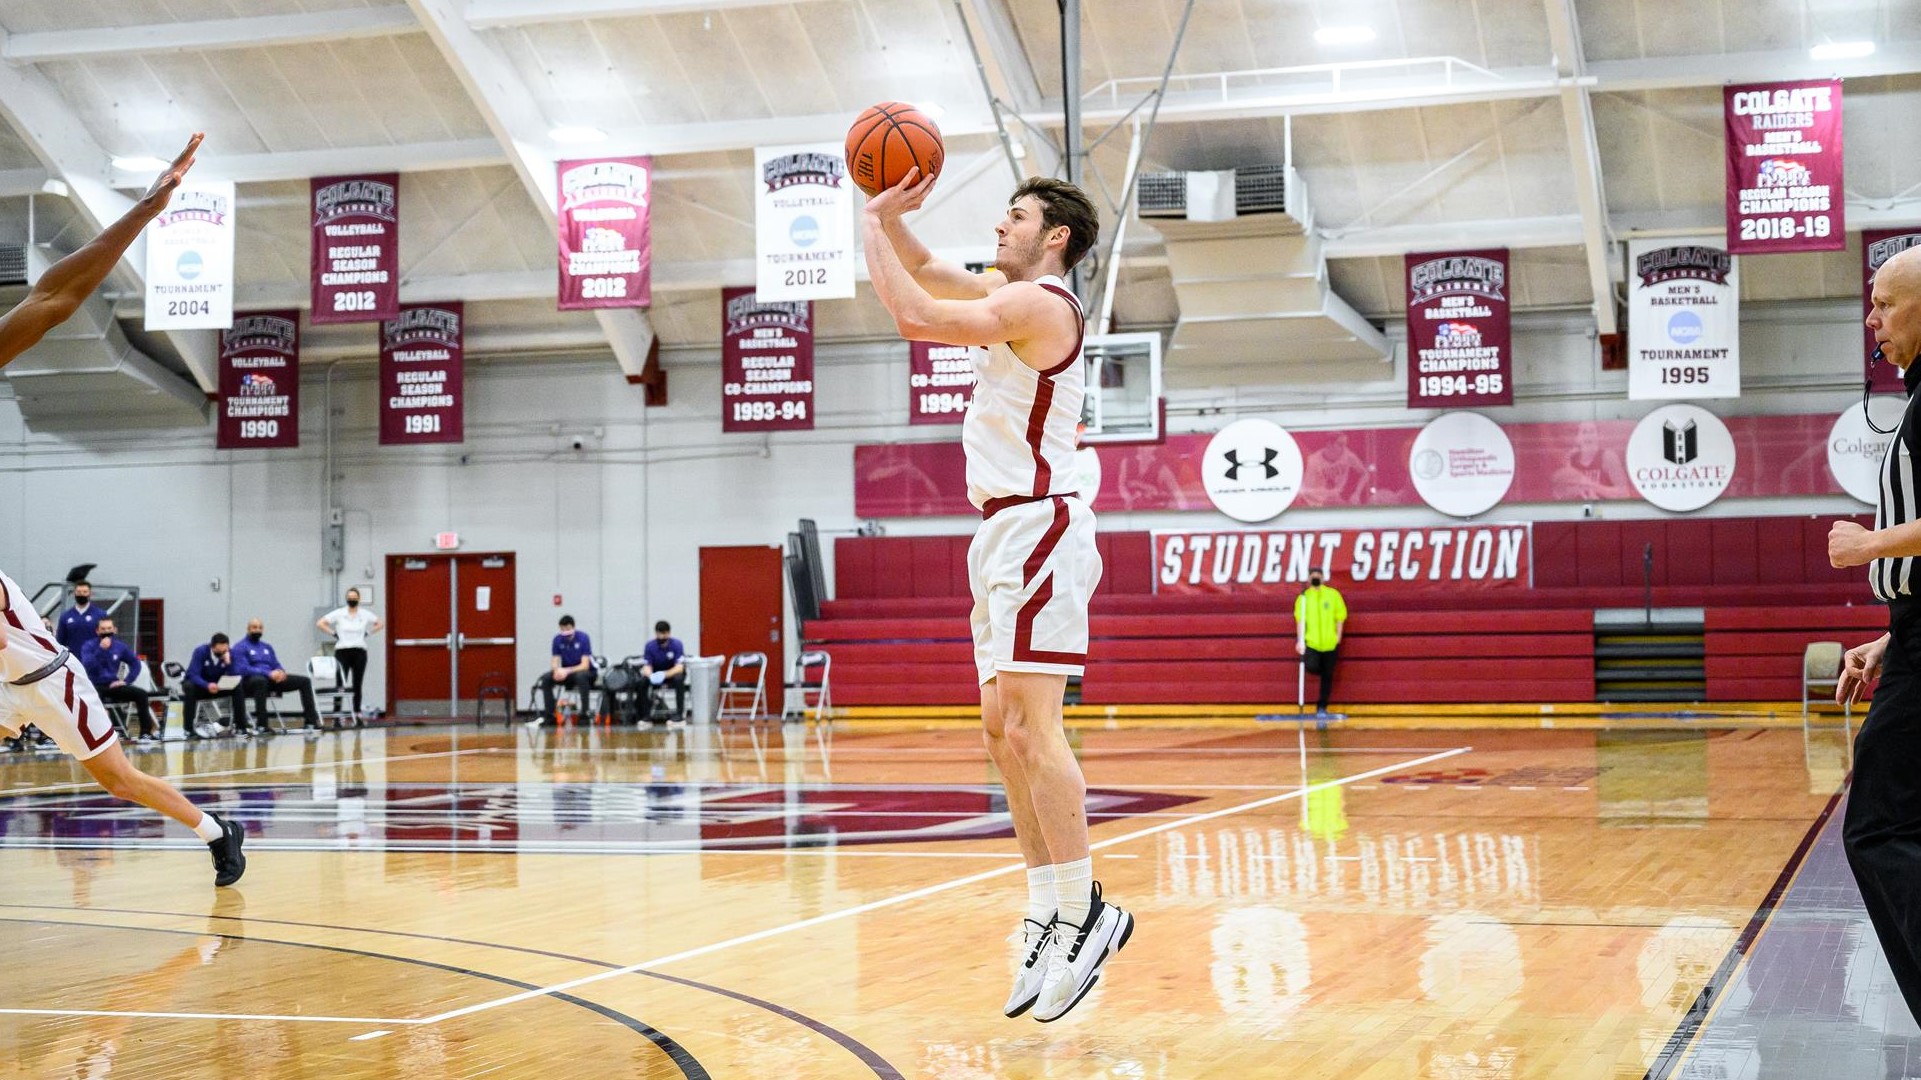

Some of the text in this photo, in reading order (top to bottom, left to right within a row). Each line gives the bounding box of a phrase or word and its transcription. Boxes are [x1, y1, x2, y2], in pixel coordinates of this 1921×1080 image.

[1733, 86, 1832, 116] COLGATE
[1752, 112, 1814, 130] RAIDERS
[1745, 140, 1823, 157] BASKETBALL
[1739, 184, 1831, 201] REGULAR SEASON
[1739, 197, 1831, 215] CHAMPIONS
[325, 223, 385, 236] VOLLEYBALL
[1740, 215, 1831, 241] 2018-19
[328, 245, 381, 259] REGULAR
[766, 250, 843, 264] TOURNAMENT
[332, 258, 377, 272] SEASON
[1637, 245, 1732, 277] COLGATE
[321, 270, 389, 286] CHAMPIONS
[784, 268, 827, 286] 2012
[1411, 256, 1504, 290] COLGATE
[1650, 269, 1718, 283] RAIDERS
[154, 284, 223, 294] TOURNAMENT
[582, 276, 627, 298] 2012
[1425, 281, 1490, 296] RAIDERS
[168, 300, 209, 316] 2004
[334, 291, 376, 312] 2012
[1441, 296, 1475, 308] MEN'S
[1650, 296, 1718, 306] BASKETBALL
[1424, 305, 1492, 319] BASKETBALL
[393, 349, 450, 362] VOLLEYBALL
[1418, 346, 1499, 360] TOURNAMENT
[1640, 349, 1729, 360] TOURNAMENT
[231, 356, 287, 368] VOLLEYBALL
[741, 355, 796, 369] REGULAR
[1419, 357, 1500, 373] CHAMPIONS
[396, 370, 447, 384] REGULAR
[1662, 367, 1710, 384] 1995
[400, 382, 443, 396] SEASON
[724, 380, 813, 395] CO-CHAMPIONS
[1419, 374, 1503, 397] 1994-95
[227, 395, 289, 405] TOURNAMENT
[389, 394, 454, 409] CHAMPIONS
[227, 404, 289, 417] CHAMPIONS
[733, 400, 807, 421] 1993-94
[240, 420, 279, 438] 1990
[405, 414, 441, 434] 1991
[1636, 465, 1727, 481] COLGATE
[1641, 480, 1722, 489] BOOKSTORE
[1160, 528, 1524, 585] STUDENT SECTION
